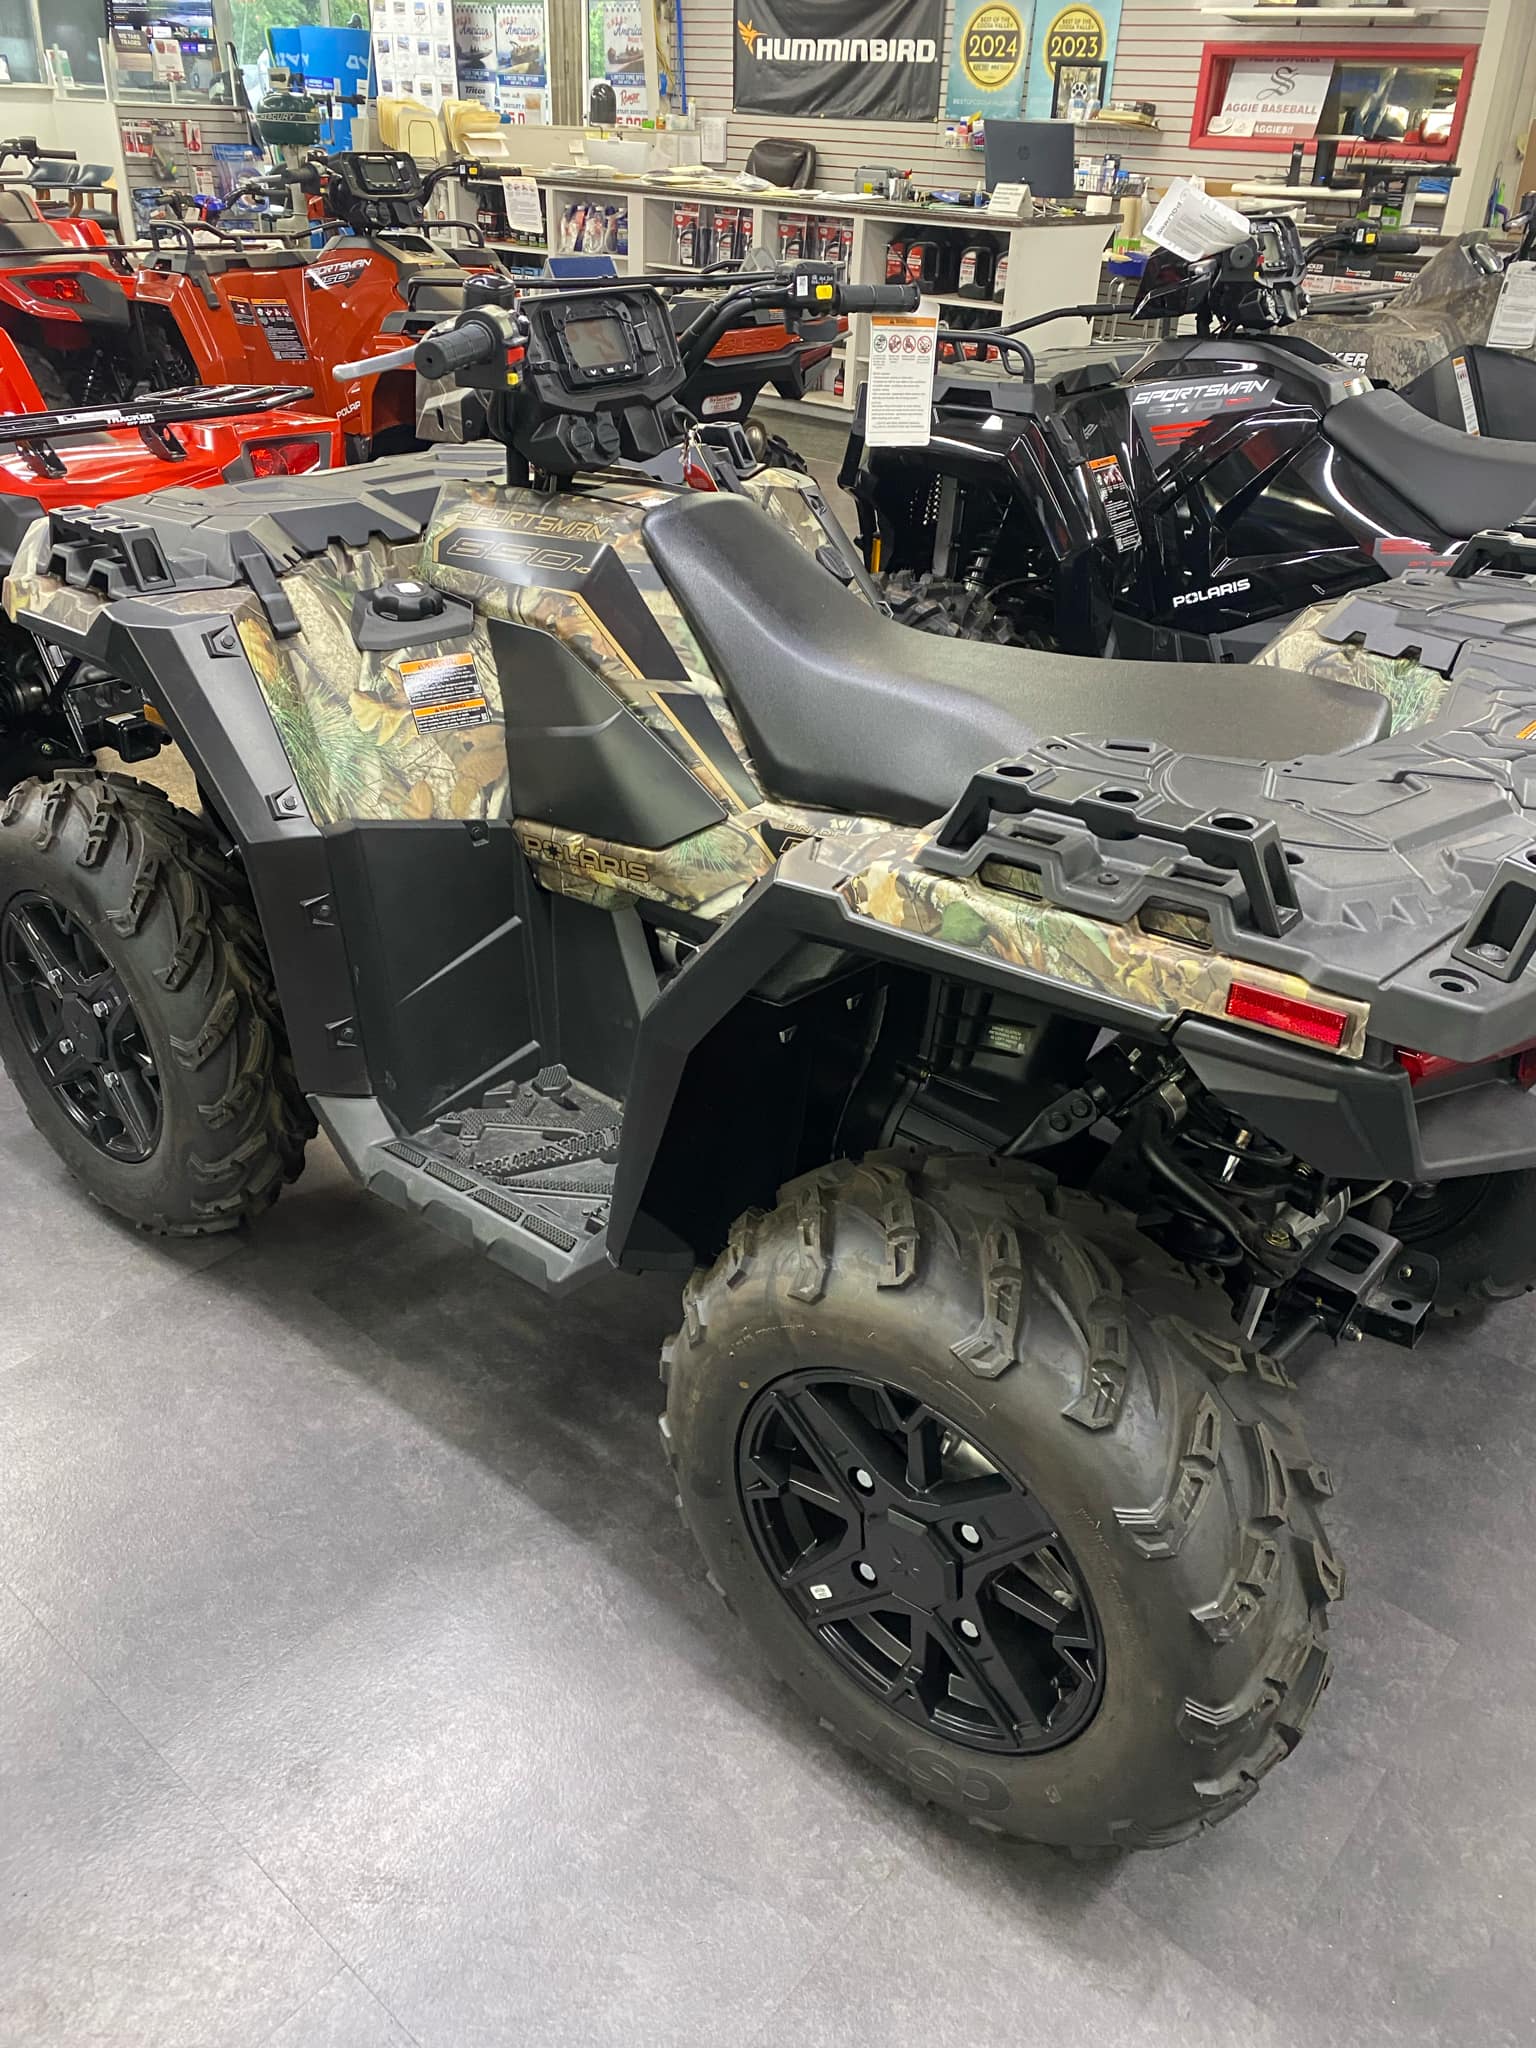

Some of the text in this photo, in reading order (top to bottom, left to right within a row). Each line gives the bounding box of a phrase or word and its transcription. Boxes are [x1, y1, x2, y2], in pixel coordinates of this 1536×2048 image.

[756, 37, 937, 63] HUMMINBIRD
[969, 34, 1018, 58] 2024
[1051, 36, 1098, 58] 2023
[1256, 66, 1300, 101] S
[1225, 103, 1318, 114] AGGIE BASEBALL
[303, 257, 372, 279] SPORTSMAN
[1132, 379, 1271, 406] SPORTSMAN
[106, 413, 154, 425] TRACKER
[1146, 398, 1224, 418] 570
[456, 505, 610, 541] SPORTSMAN
[446, 537, 584, 572] 850
[1172, 578, 1251, 608] POLARIS
[438, 703, 467, 713] WARNING
[522, 834, 651, 883] POLARIS
